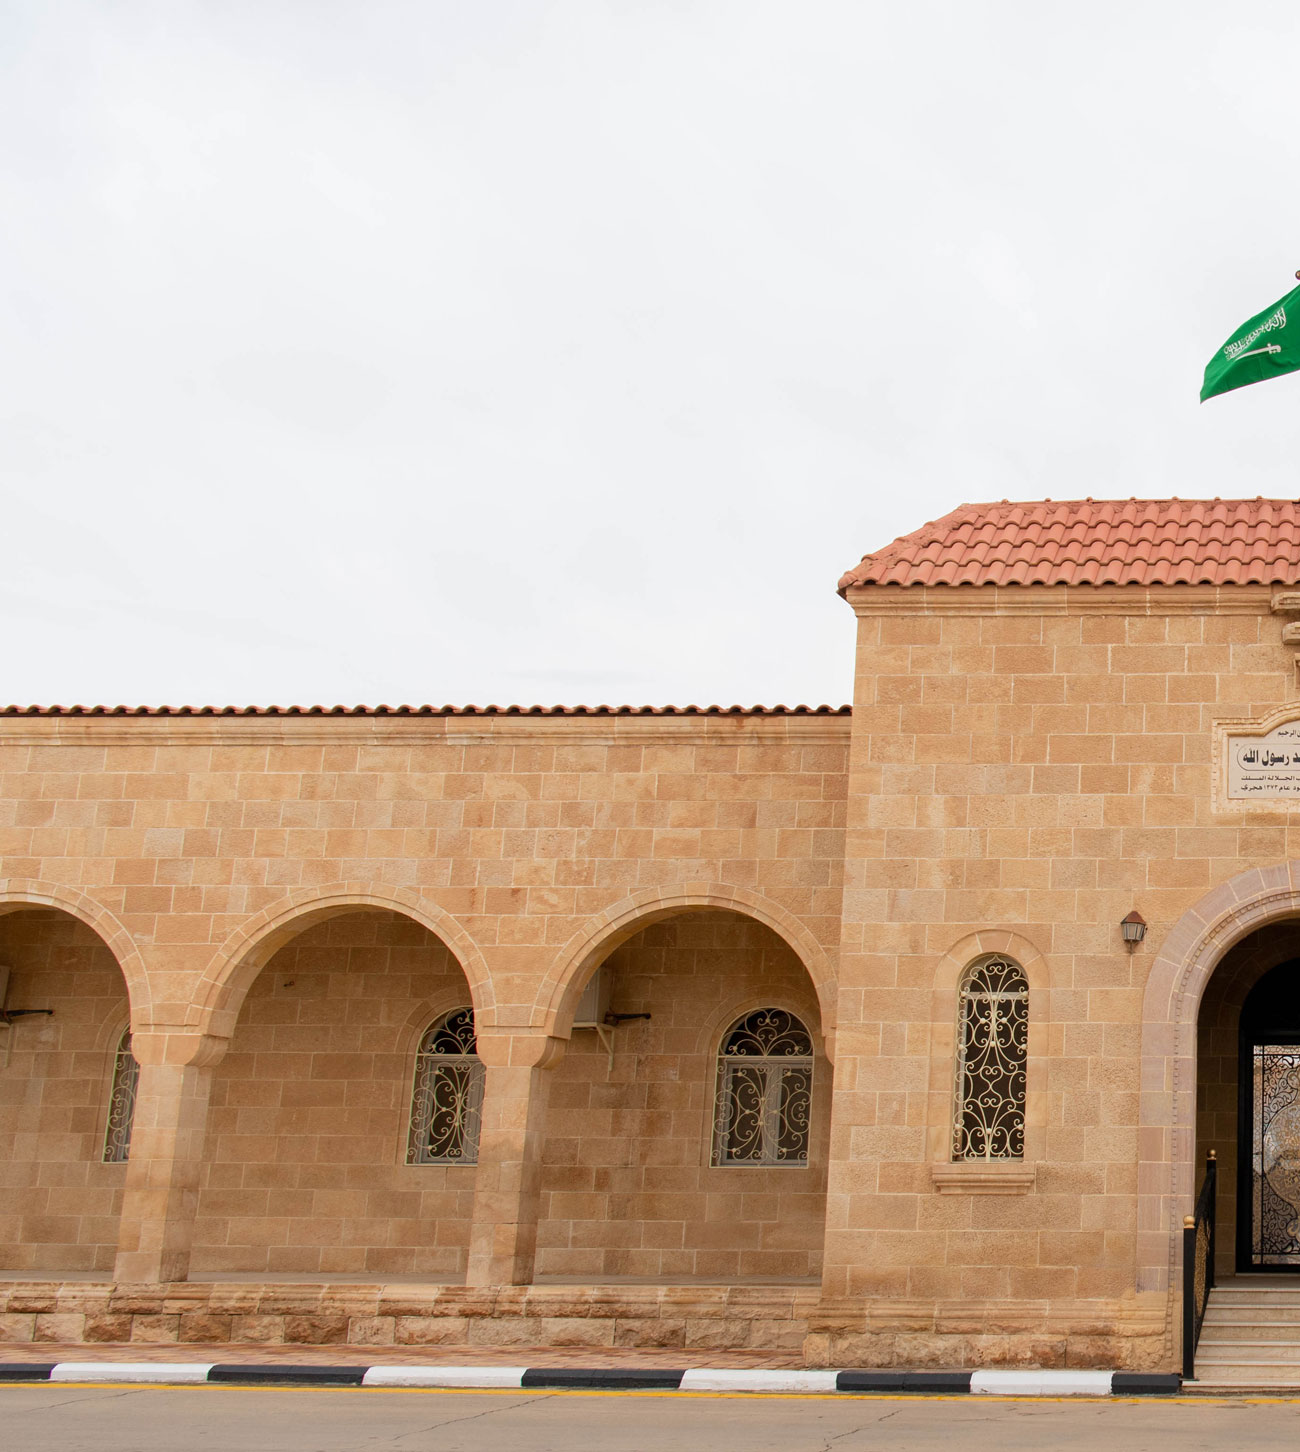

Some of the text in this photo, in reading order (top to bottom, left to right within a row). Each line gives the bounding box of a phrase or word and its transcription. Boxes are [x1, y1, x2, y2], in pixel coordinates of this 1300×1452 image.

[1277, 729, 1297, 738] الرحيم
[1243, 747, 1259, 763] الله
[1262, 750, 1290, 766] رسول
[1278, 785, 1290, 793] عام
